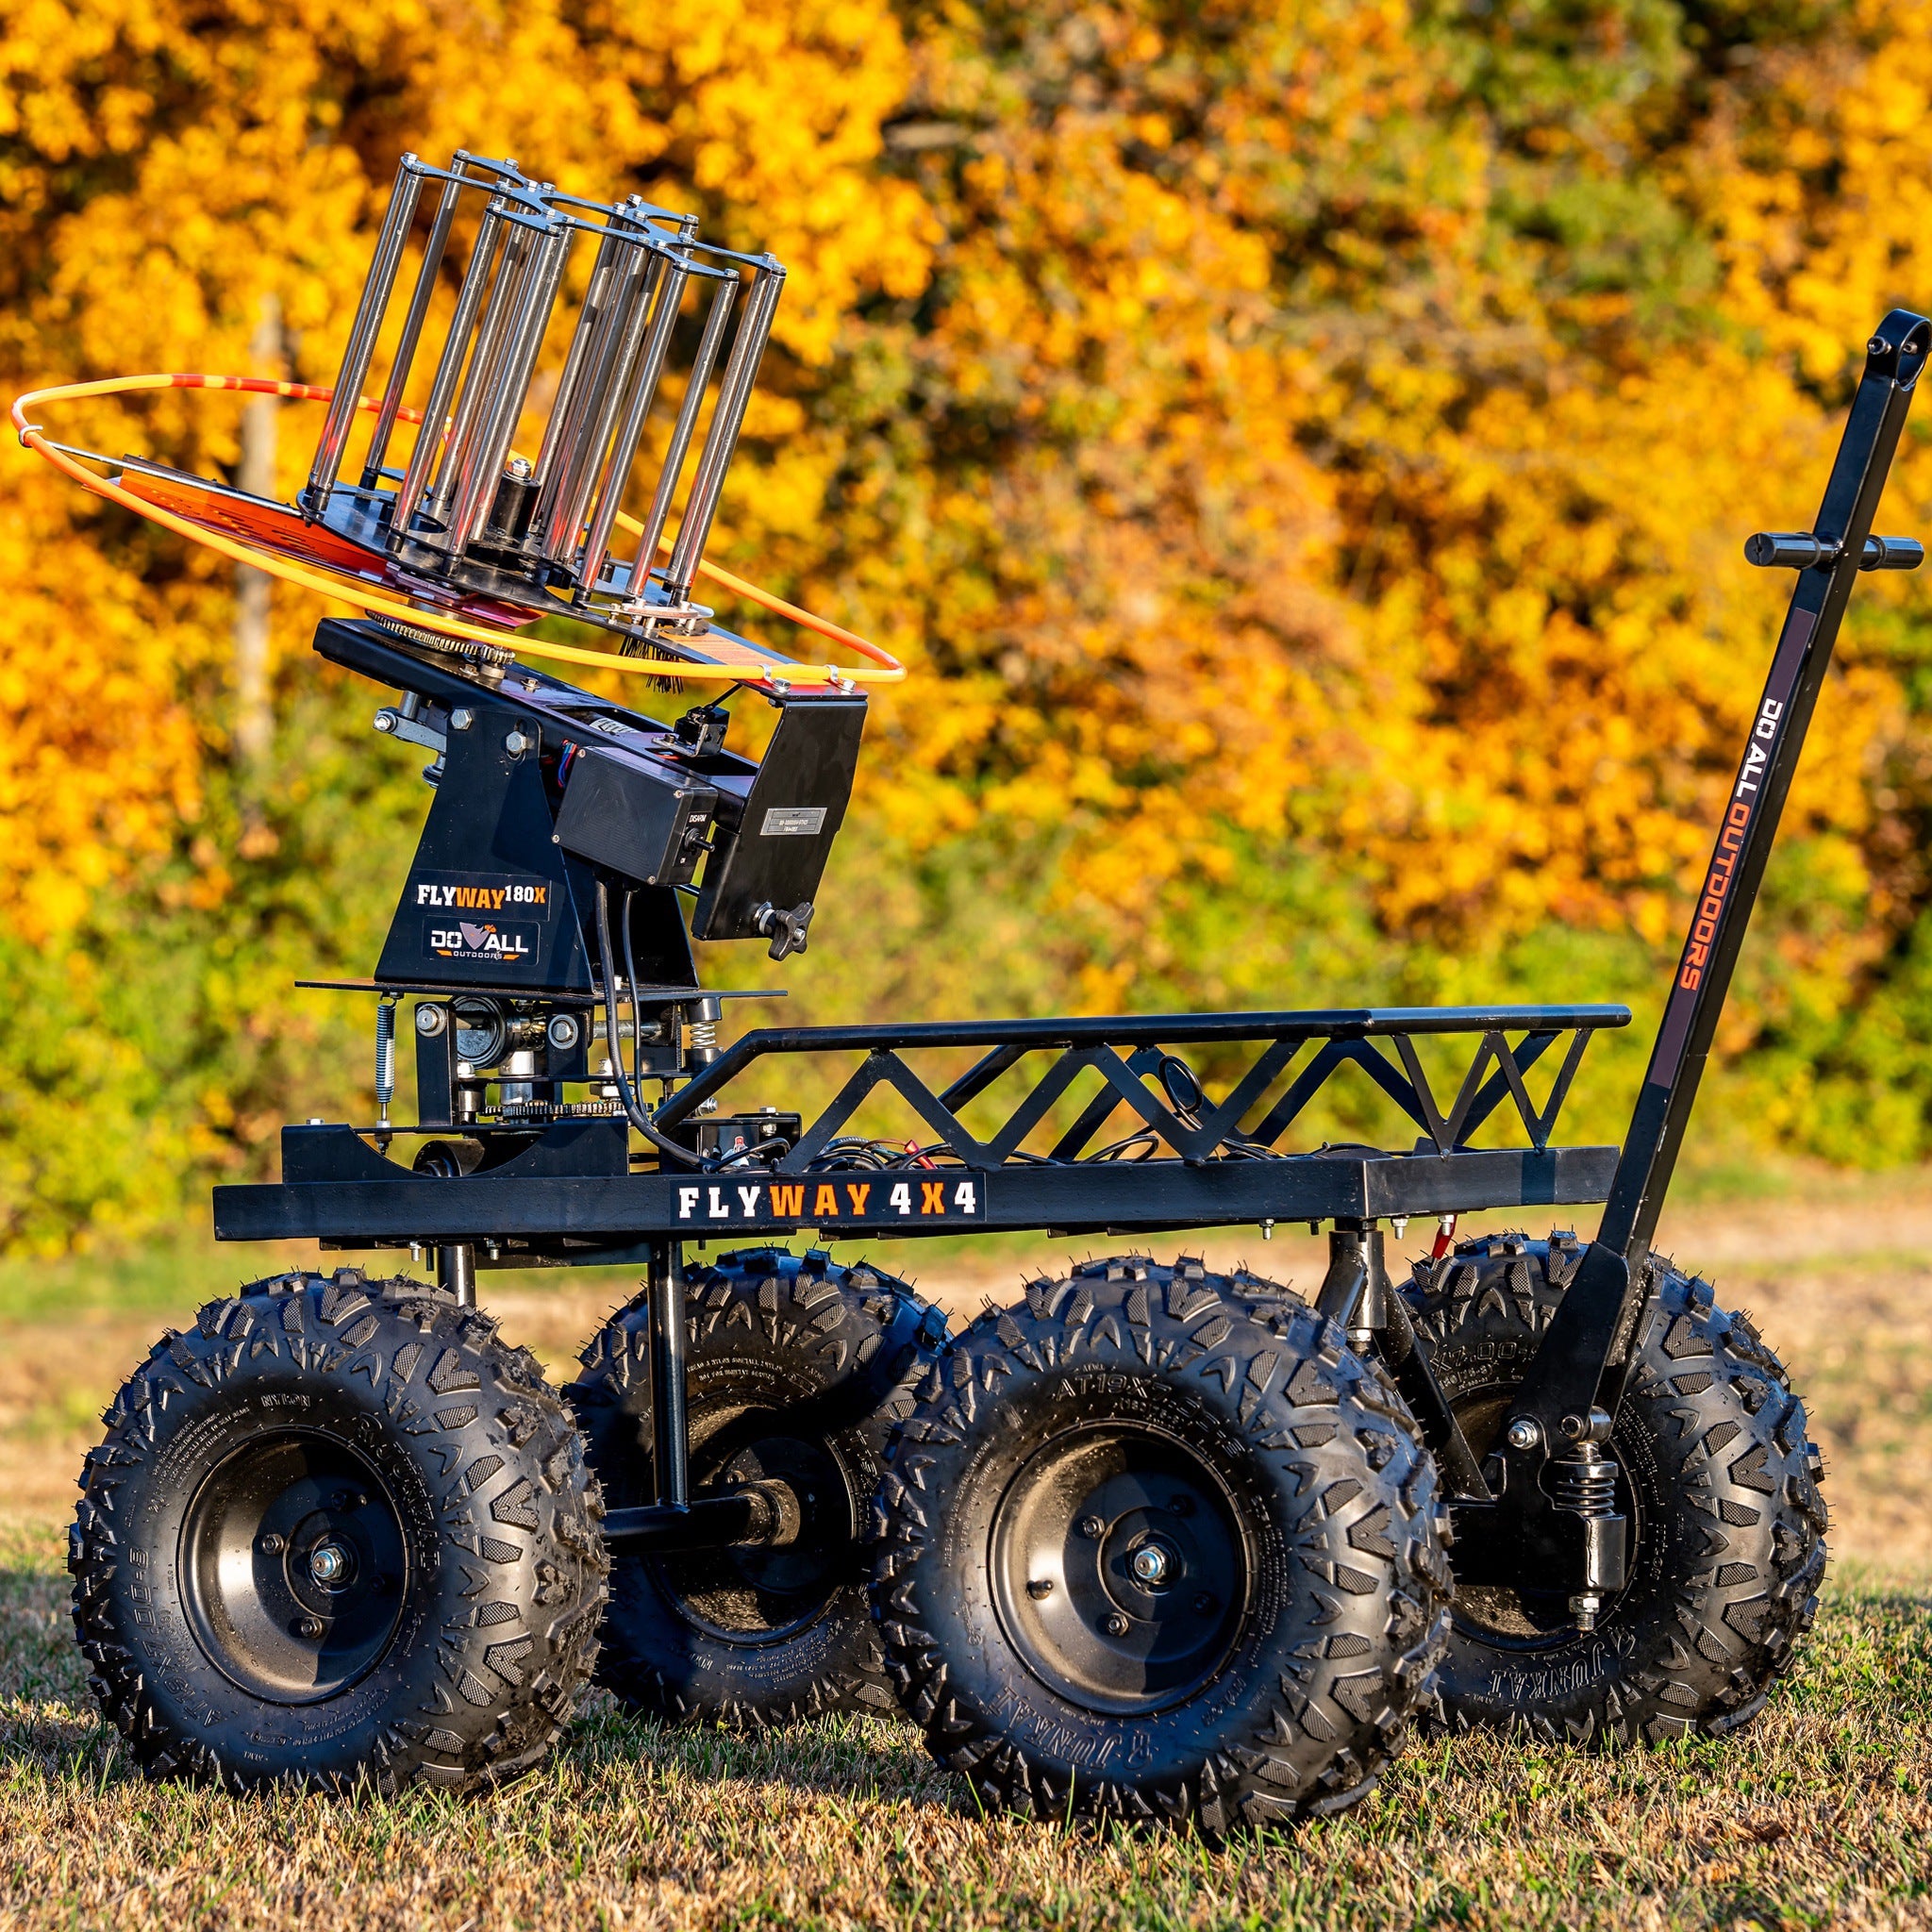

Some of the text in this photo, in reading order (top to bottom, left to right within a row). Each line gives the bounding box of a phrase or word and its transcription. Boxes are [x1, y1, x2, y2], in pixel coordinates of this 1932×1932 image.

[1679, 697, 1784, 991] DO ALL OUTDOORS
[430, 929, 529, 953] DO ALL
[453, 950, 503, 959] OUTDOORS
[678, 1182, 975, 1219] FLYWAY 4X4
